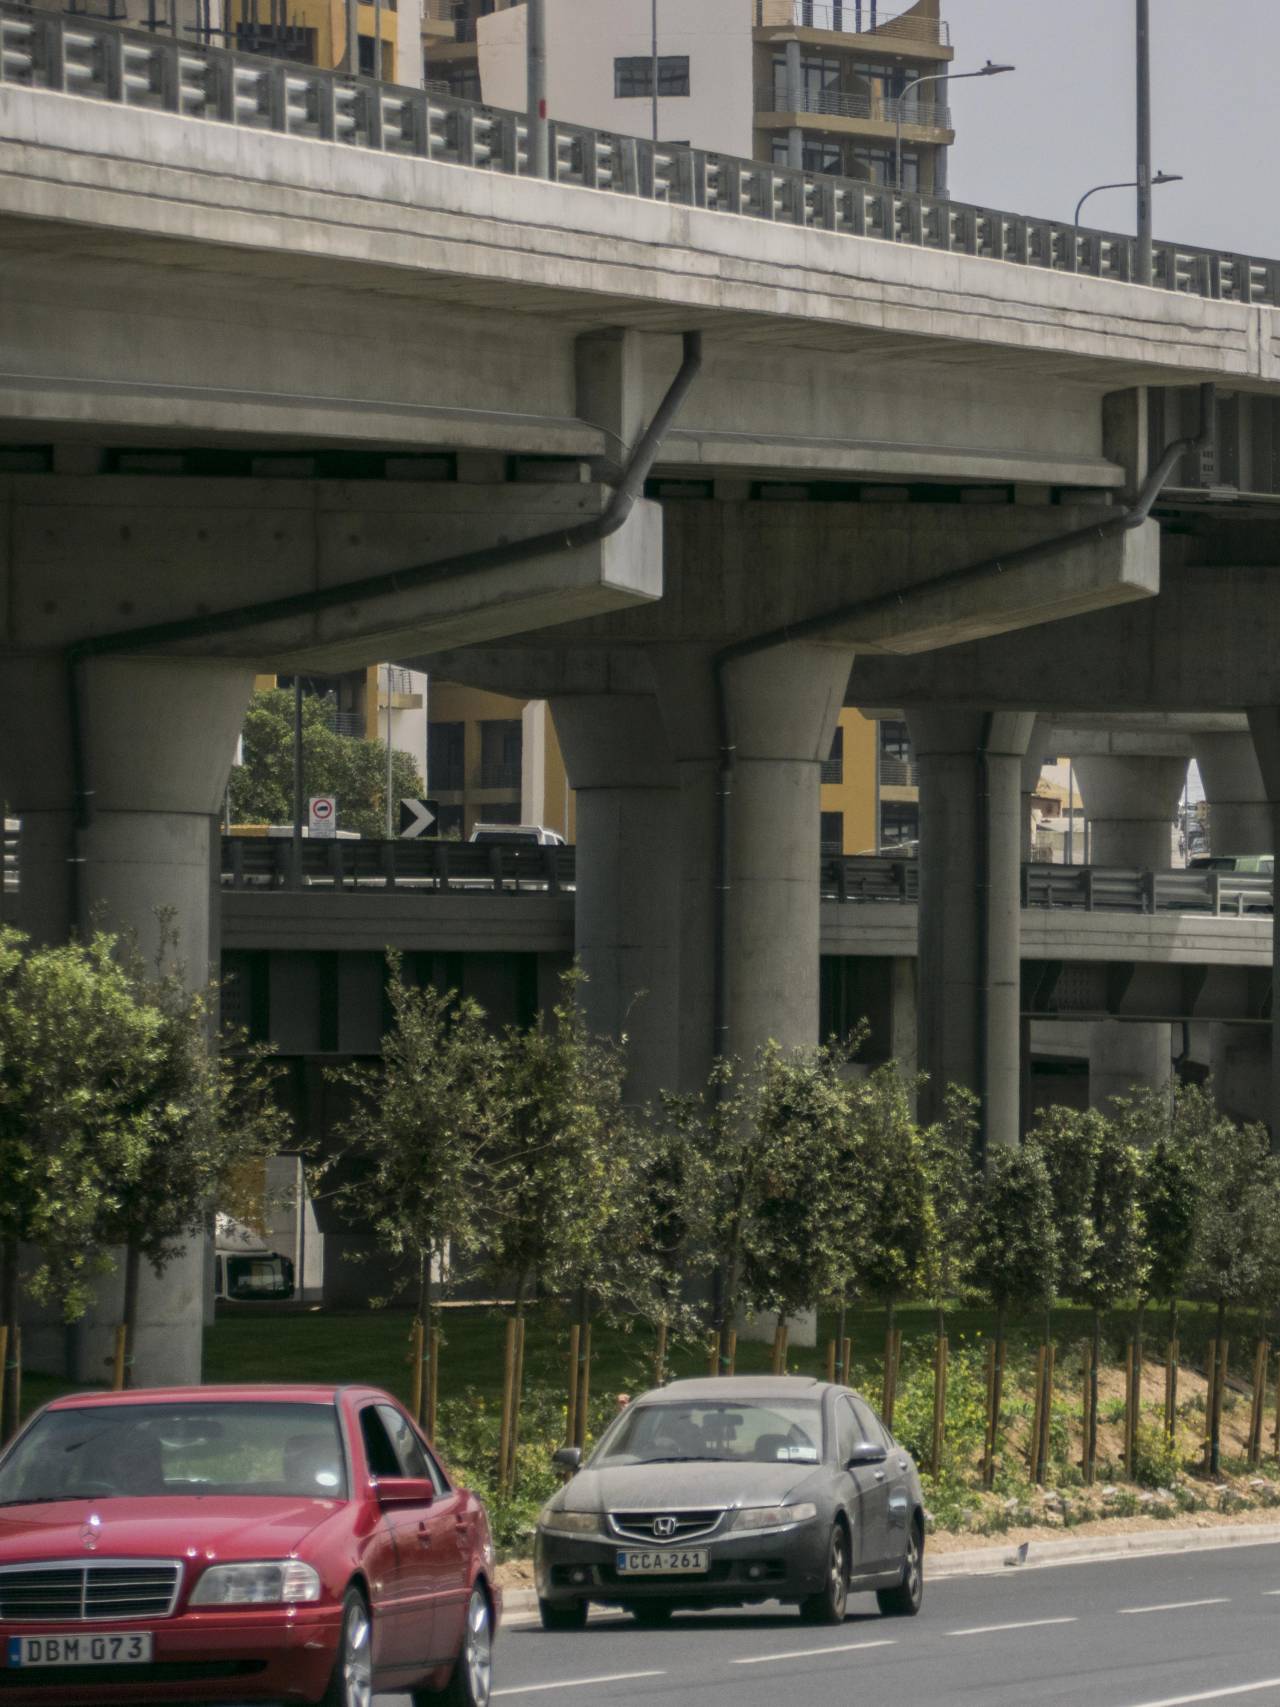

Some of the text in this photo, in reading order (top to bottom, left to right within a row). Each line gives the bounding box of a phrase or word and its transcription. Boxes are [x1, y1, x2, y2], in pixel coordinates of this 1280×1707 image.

[629, 1553, 701, 1569] CCA 261
[27, 1637, 142, 1662] DBM 073
